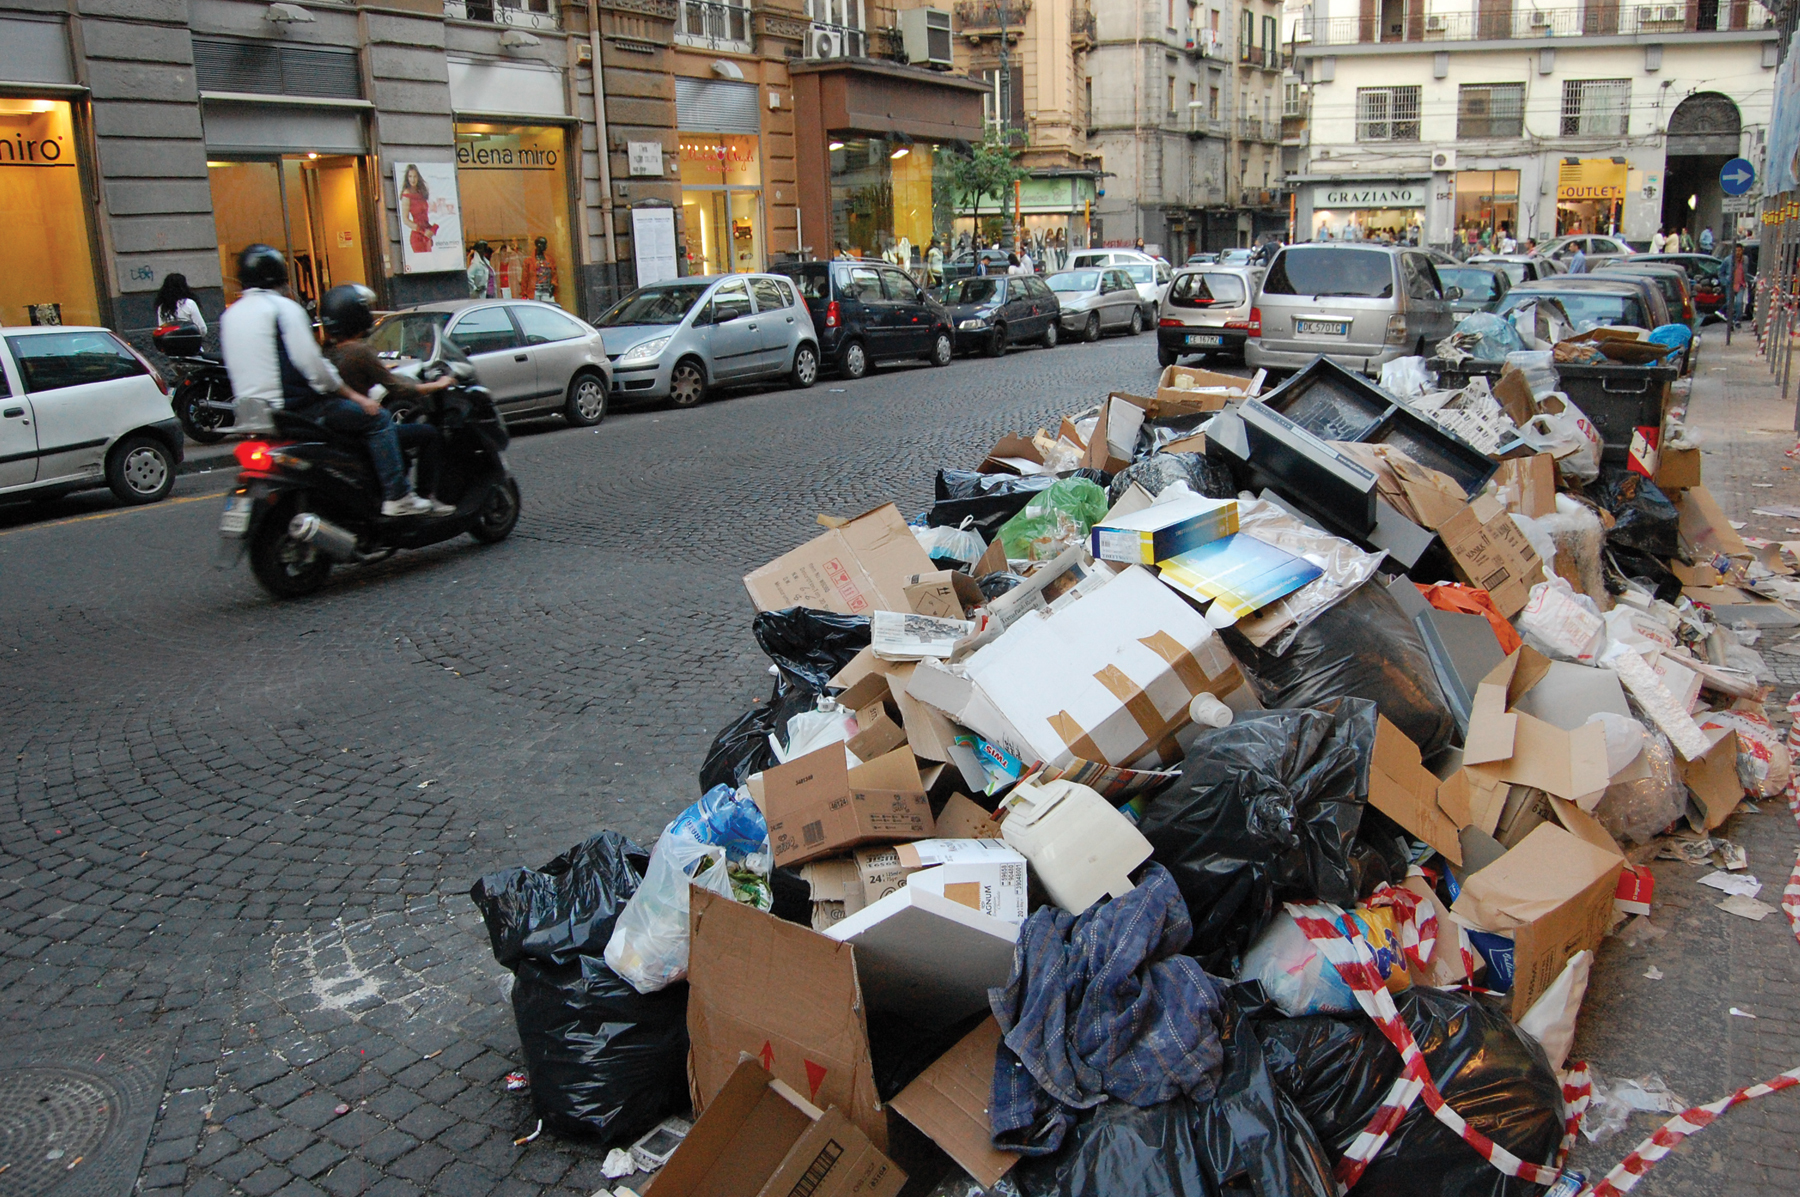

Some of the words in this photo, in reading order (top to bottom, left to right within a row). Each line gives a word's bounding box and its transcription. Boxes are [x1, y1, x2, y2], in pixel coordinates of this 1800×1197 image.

[457, 142, 513, 165] elena
[1327, 190, 1412, 203] GRAZIANO
[1566, 186, 1617, 197] OUTLET
[685, 819, 705, 844] PRATA
[870, 874, 882, 884] 24
[983, 885, 992, 916] AGNUM
